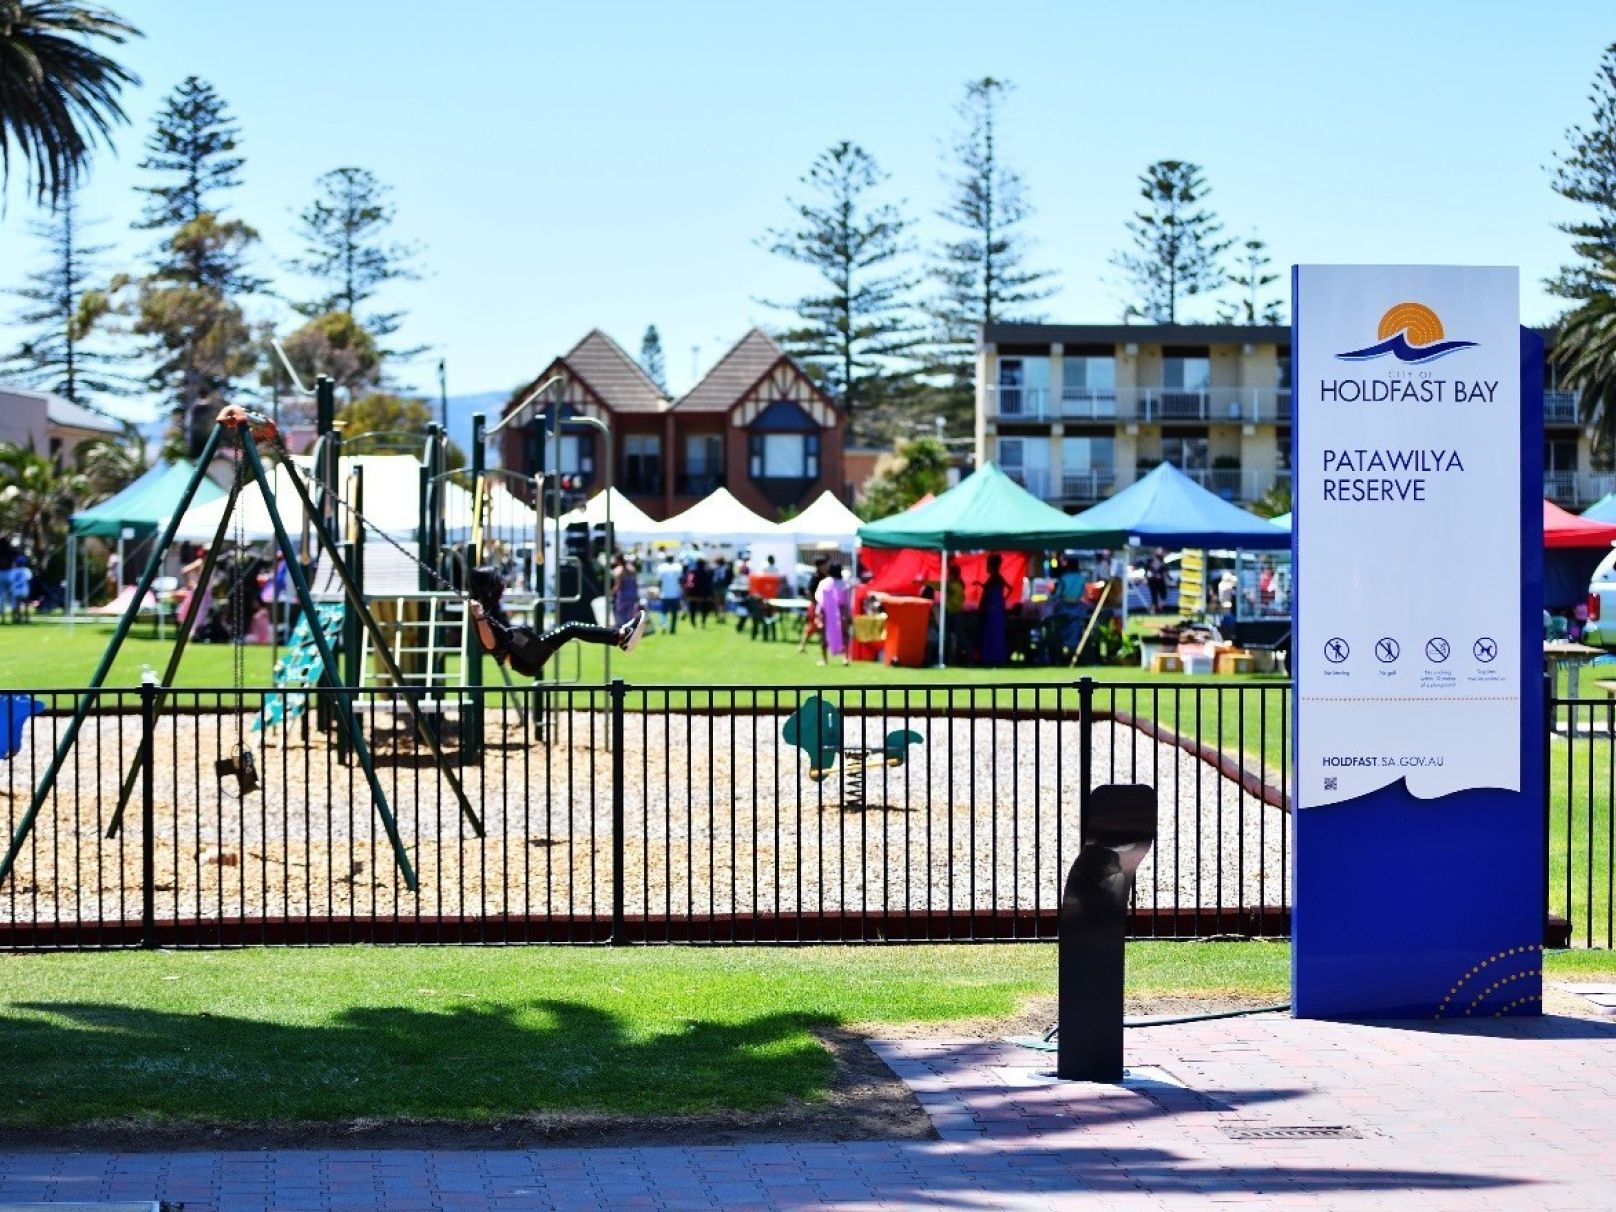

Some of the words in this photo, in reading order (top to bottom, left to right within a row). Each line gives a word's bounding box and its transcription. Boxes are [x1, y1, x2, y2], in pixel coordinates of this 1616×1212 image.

[1320, 380, 1446, 402] HOLDFAST
[1454, 380, 1499, 403] BAY
[1323, 450, 1464, 472] PATAWILYA
[1323, 479, 1426, 502] RESERVE
[1322, 756, 1444, 767] HOLDFAST.SA.GOV.AU
